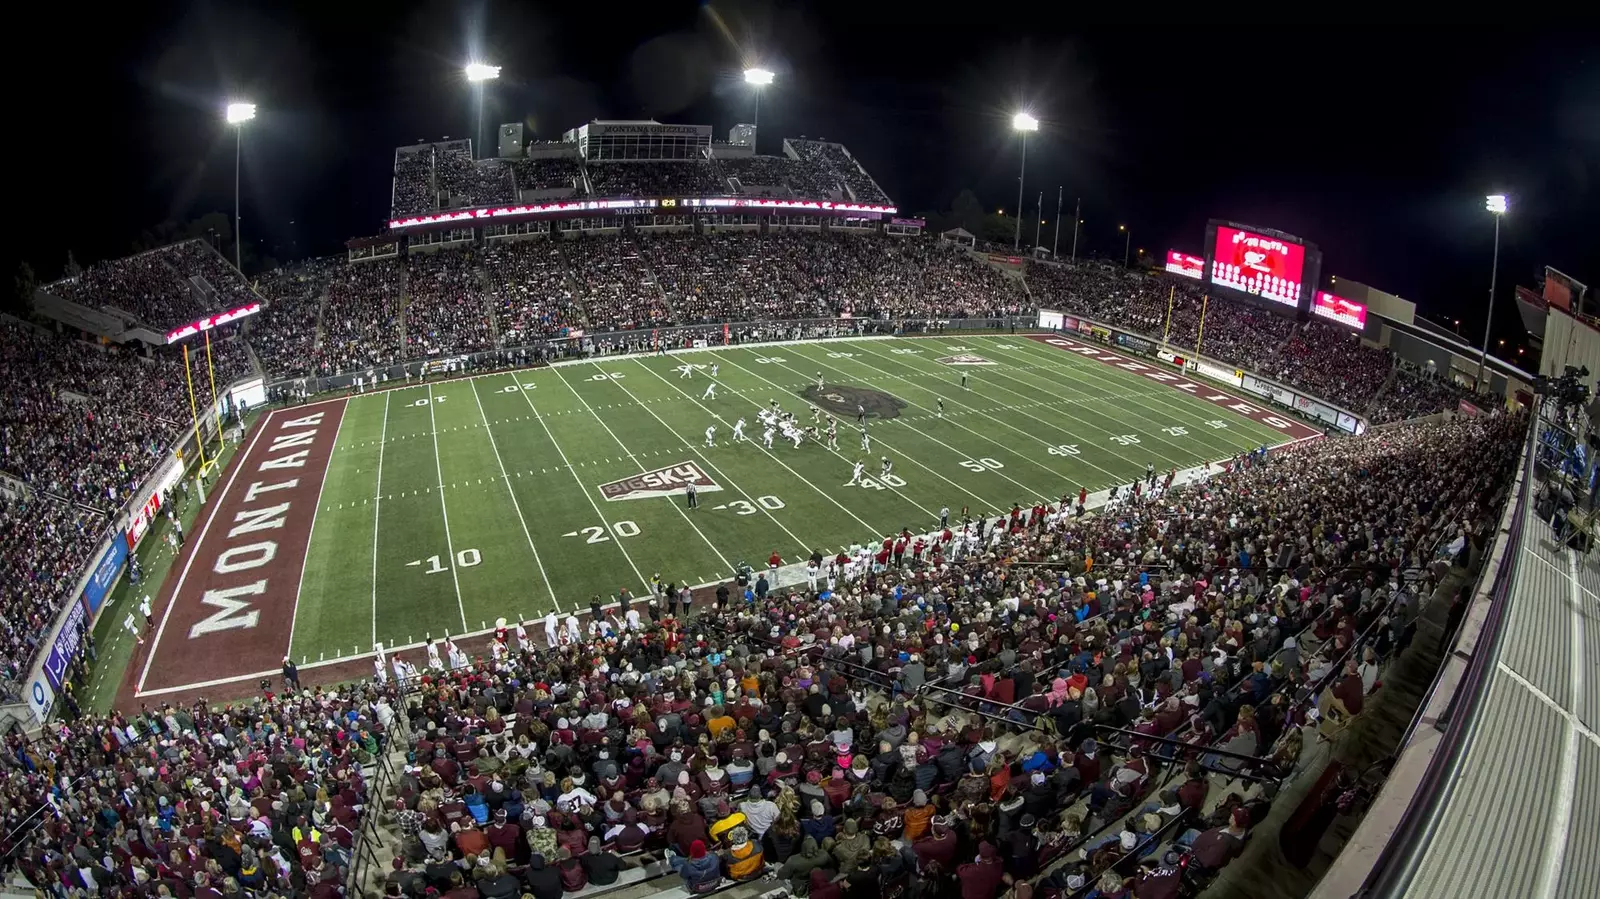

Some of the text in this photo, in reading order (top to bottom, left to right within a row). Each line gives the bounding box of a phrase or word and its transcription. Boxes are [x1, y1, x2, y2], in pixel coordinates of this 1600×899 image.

[604, 125, 648, 133] MONTANA
[592, 372, 626, 381] 30
[504, 382, 538, 393] 20
[1046, 338, 1293, 430] GRIZZLIES
[415, 395, 447, 406] 10
[1161, 426, 1188, 437] 20
[1109, 434, 1141, 446] 30
[1047, 445, 1080, 457] 40
[959, 457, 1004, 473] 50
[728, 495, 786, 515] 30
[188, 411, 326, 640] MONTANA
[580, 520, 641, 544] 20
[425, 548, 483, 574] 10
